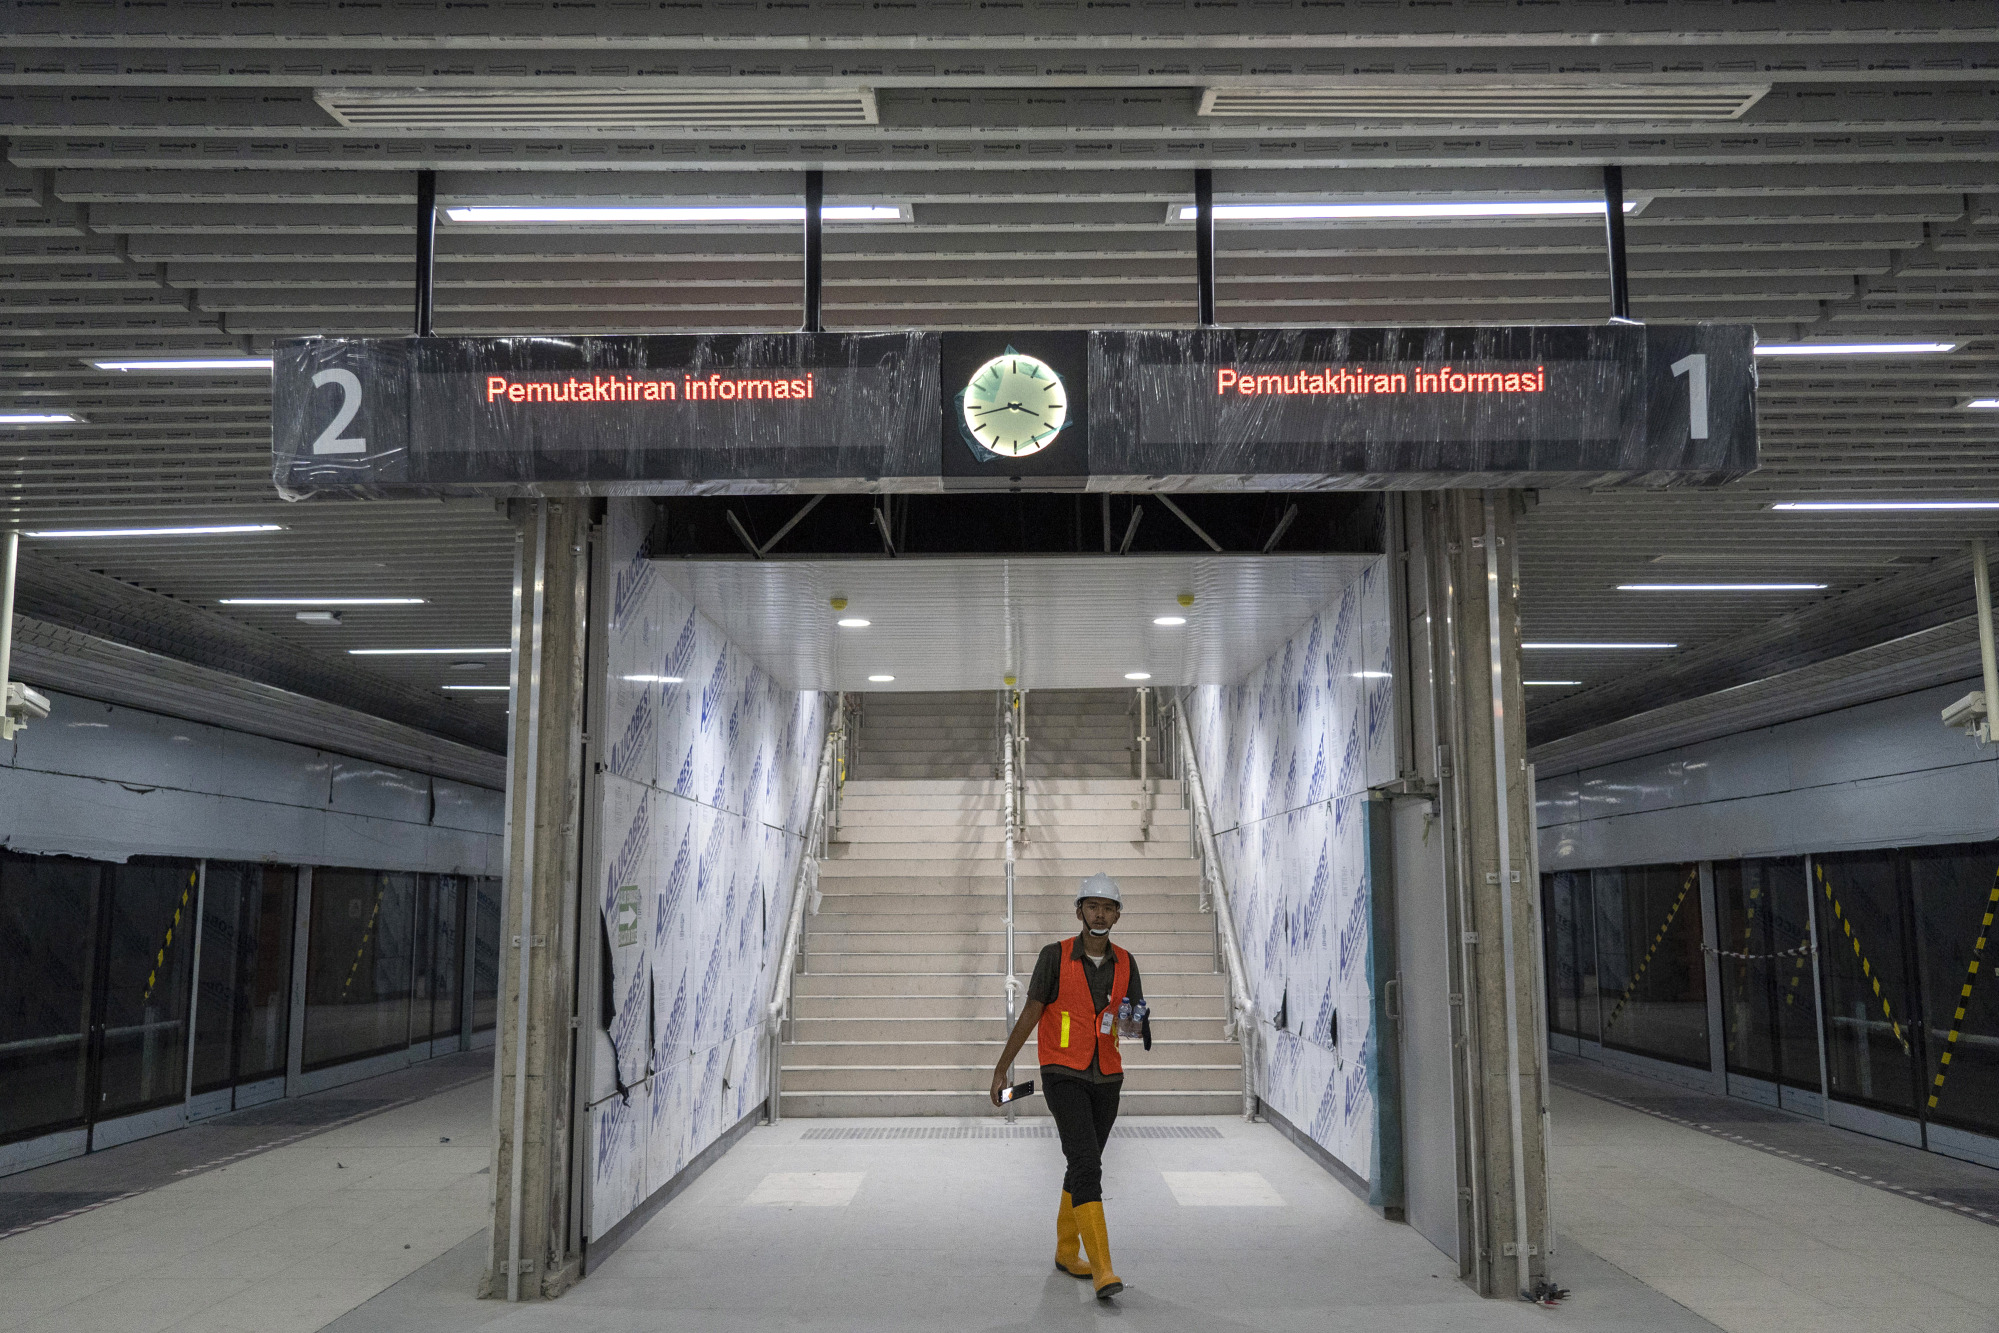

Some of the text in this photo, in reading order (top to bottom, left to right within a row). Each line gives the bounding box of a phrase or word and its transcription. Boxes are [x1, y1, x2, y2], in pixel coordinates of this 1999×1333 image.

[310, 367, 367, 455] 2
[486, 372, 813, 403] Pemutakhiran informasi
[1217, 365, 1544, 397] Pemutakhiran informasi
[1670, 353, 1710, 440] 1
[662, 604, 696, 706] ALUCOBEST
[700, 639, 728, 734] ALUCOBEST
[605, 786, 649, 922] ALUCOBEST
[655, 821, 691, 950] ALUCOBEST
[1304, 838, 1327, 950] ALUCOBEST
[651, 966, 687, 1135] ALUCOBEST
